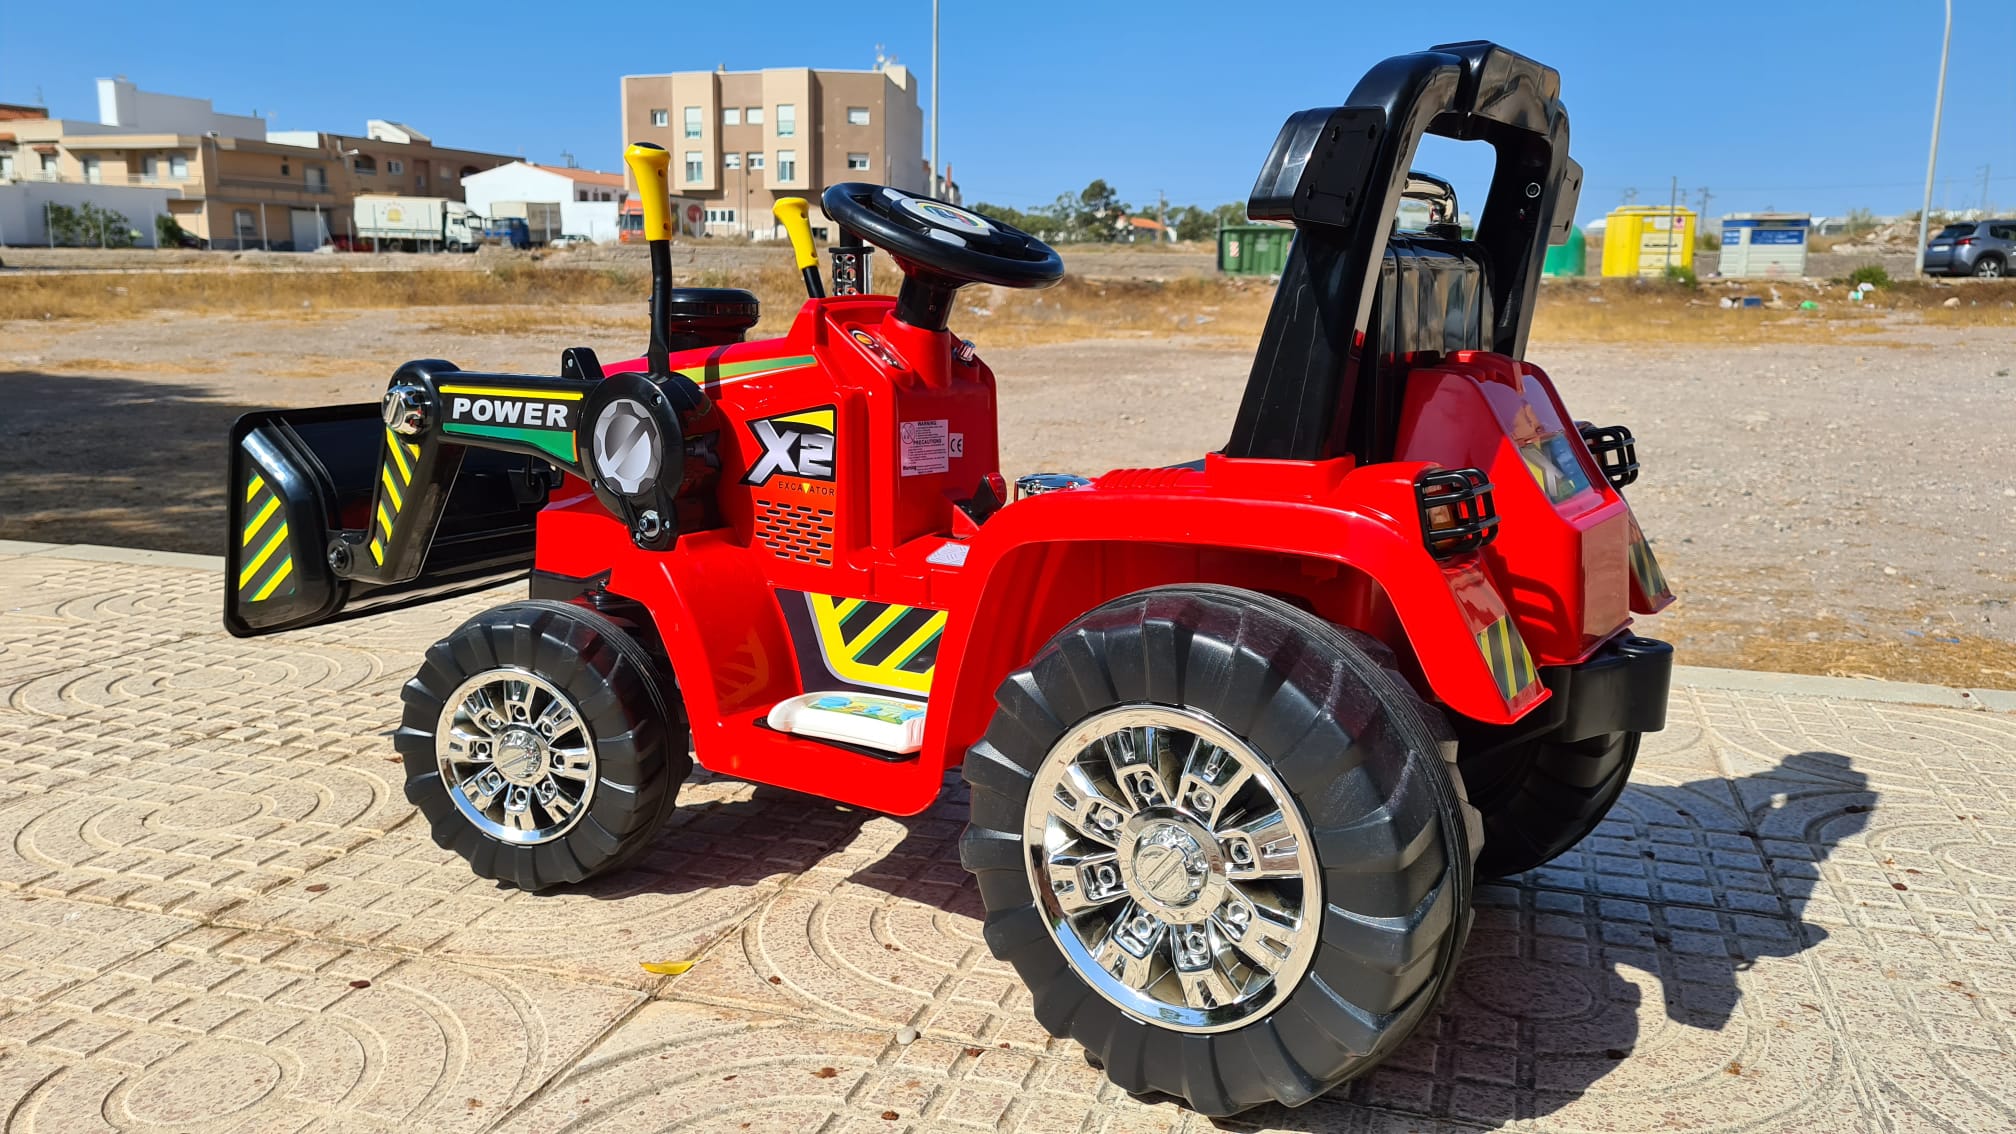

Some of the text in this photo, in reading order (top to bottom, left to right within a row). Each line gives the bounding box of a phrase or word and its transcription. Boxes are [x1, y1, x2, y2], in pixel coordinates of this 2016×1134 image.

[452, 398, 568, 427] POWER
[747, 419, 835, 484] X2
[778, 481, 835, 497] EXCAVATOR
